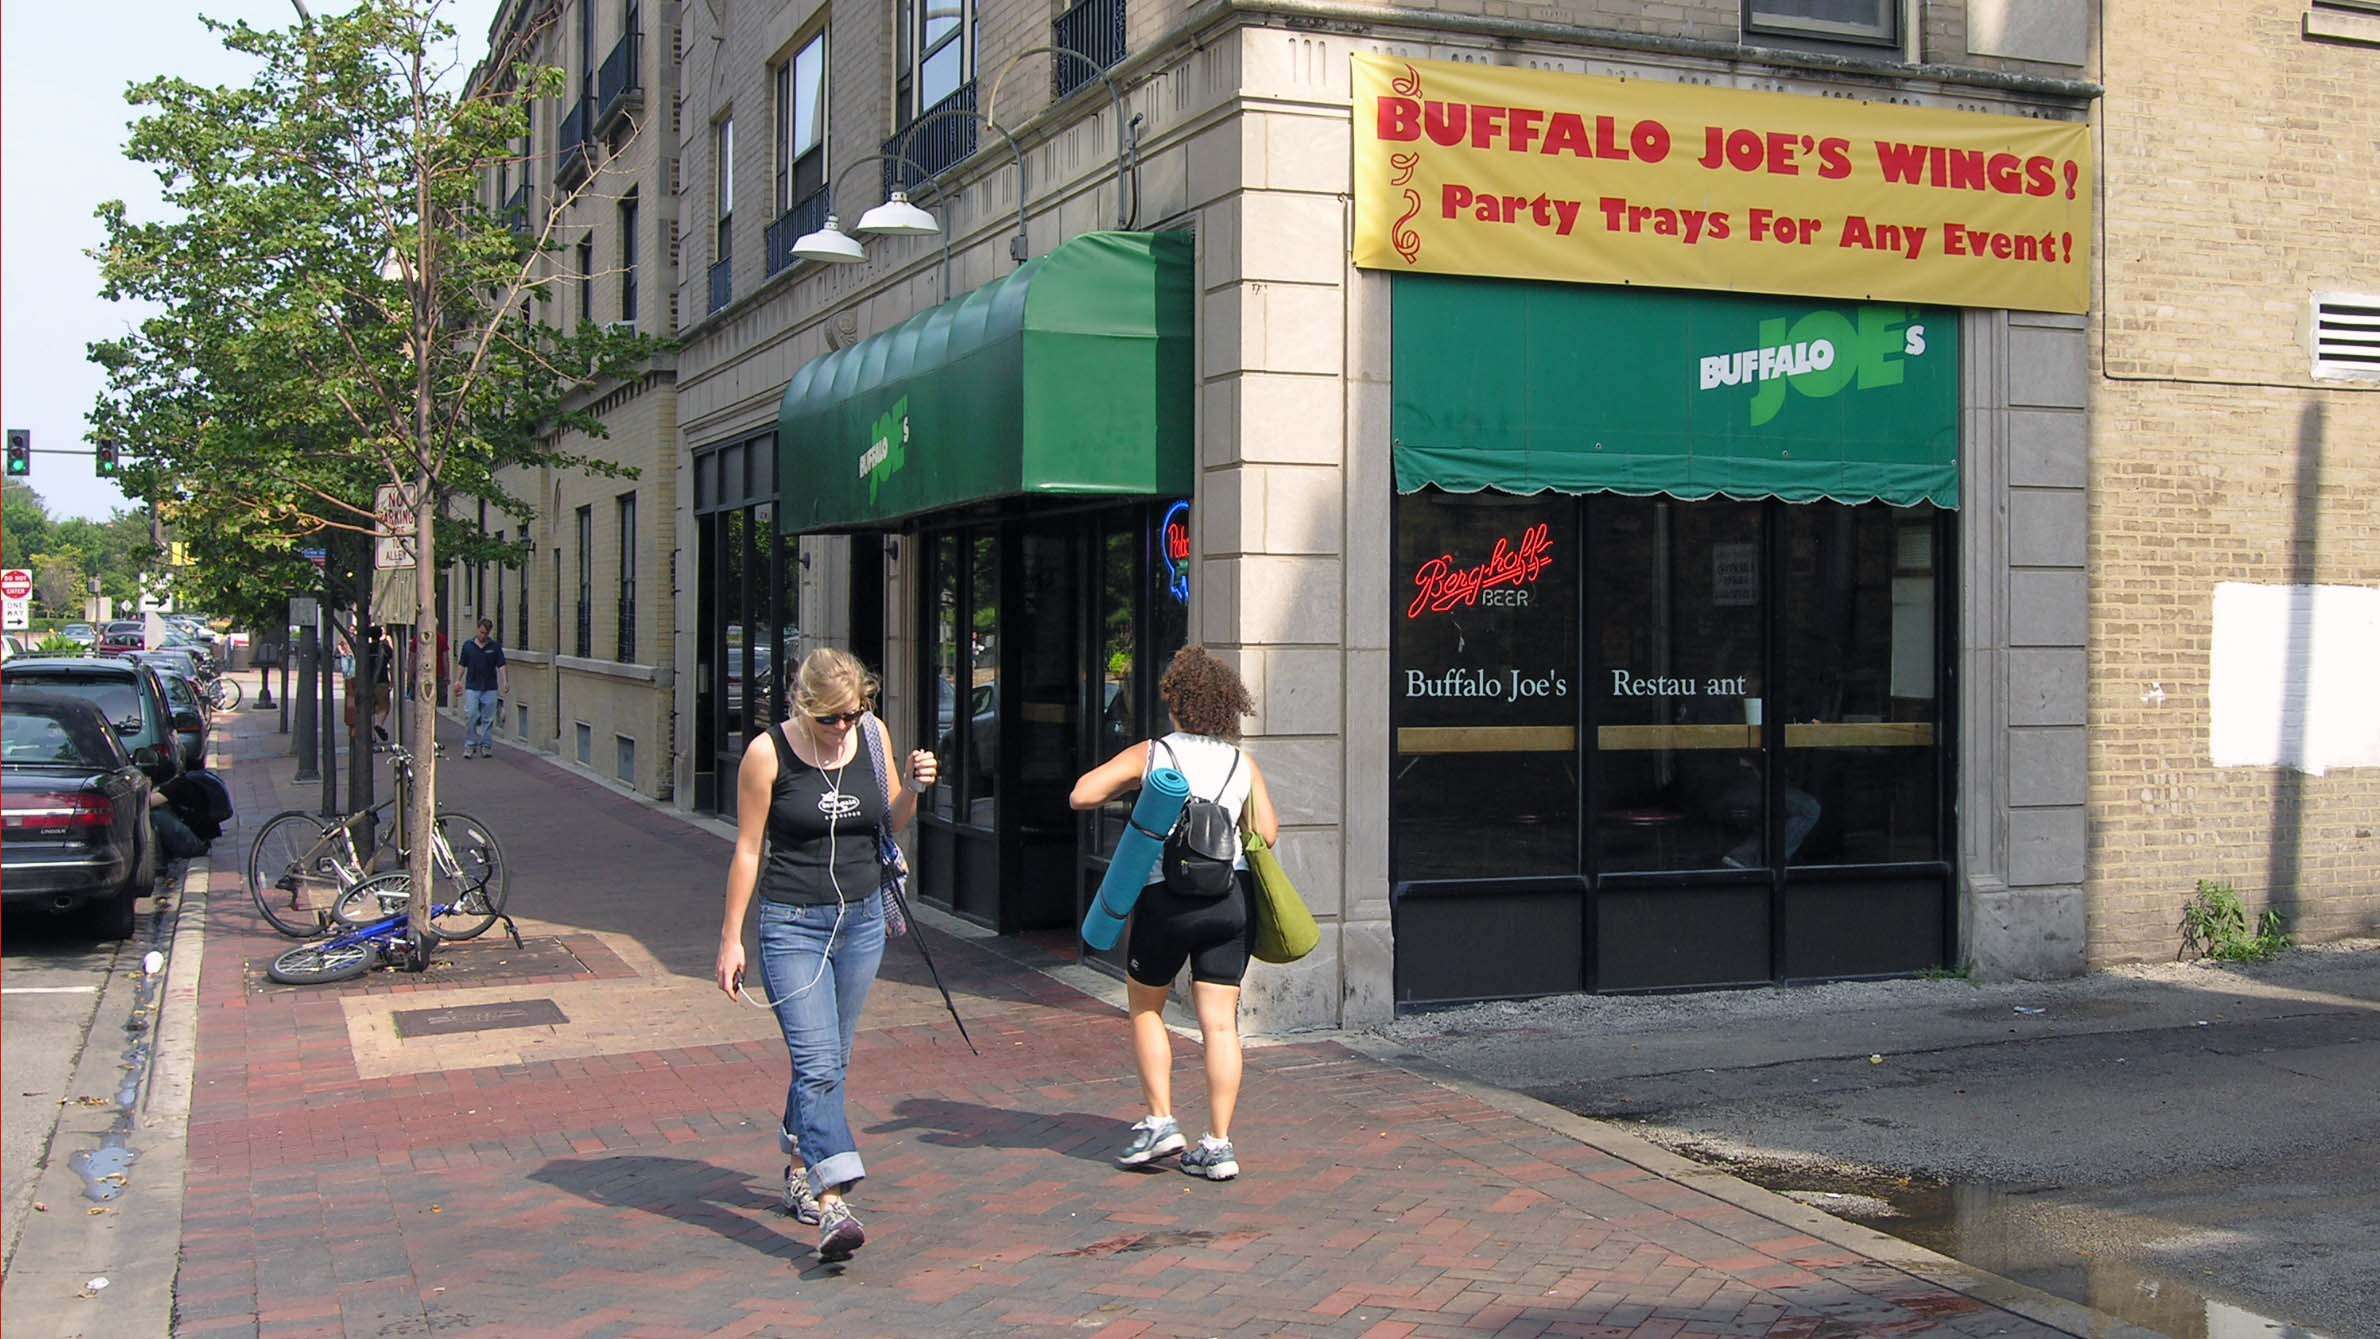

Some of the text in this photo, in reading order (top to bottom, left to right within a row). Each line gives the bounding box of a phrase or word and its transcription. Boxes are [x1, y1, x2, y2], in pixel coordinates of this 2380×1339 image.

[1377, 95, 2079, 201] BUFFALO JOE'S WINGS!
[1441, 184, 2073, 264] Party Trays For Any Event!
[1700, 339, 1835, 391] BUFFALO
[859, 436, 888, 479] BUFFALO
[381, 510, 414, 525] ARKING
[1407, 522, 1554, 619] Berghoff
[1481, 589, 1529, 607] BEER
[1405, 668, 1567, 703] Buffalo Joe's
